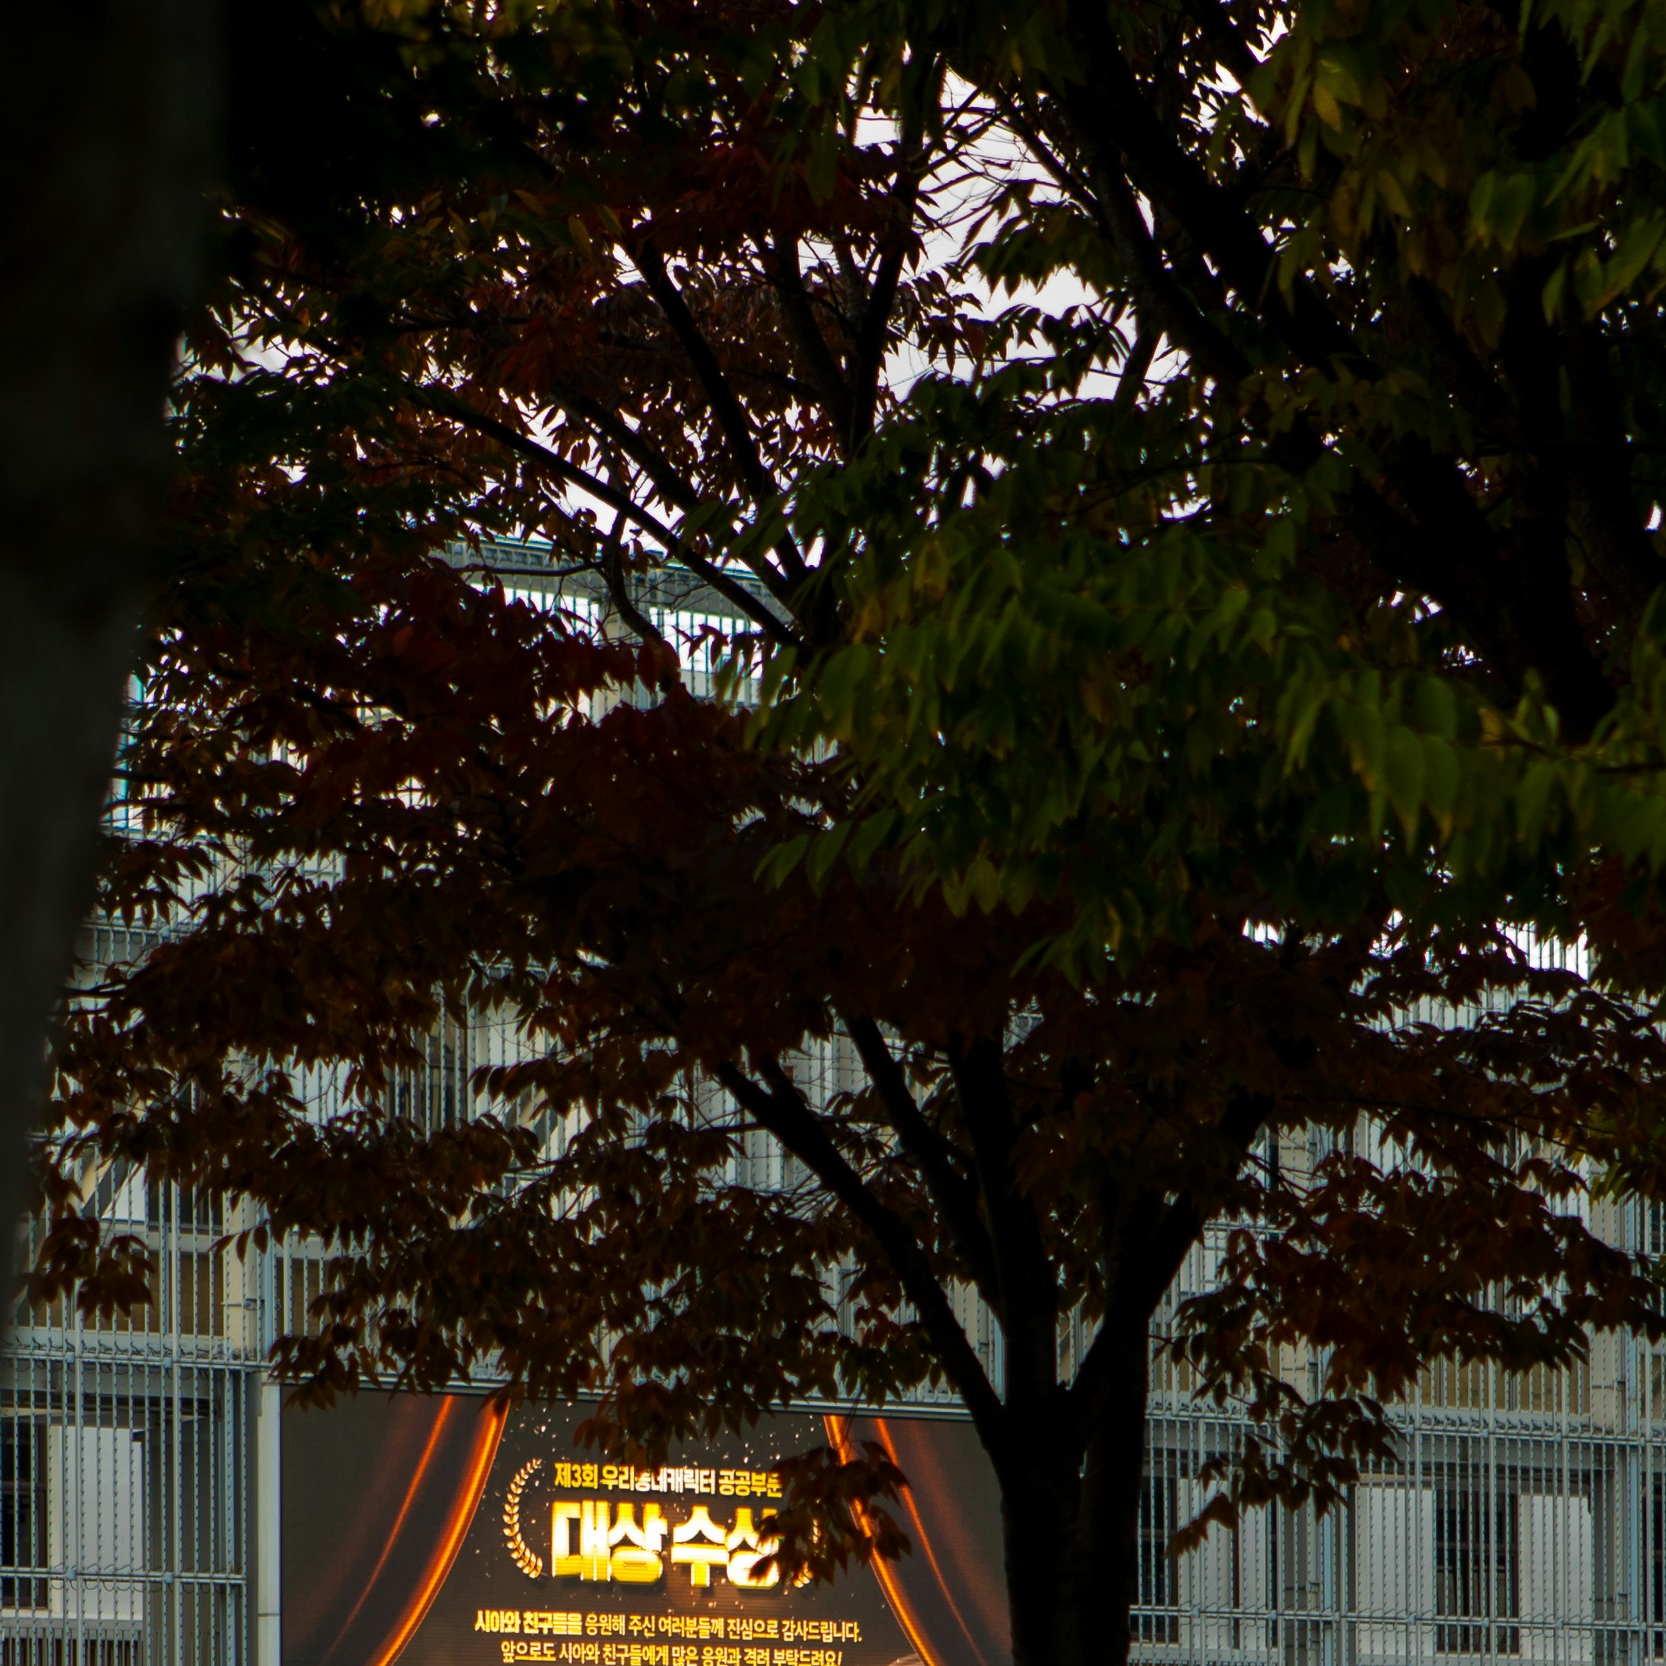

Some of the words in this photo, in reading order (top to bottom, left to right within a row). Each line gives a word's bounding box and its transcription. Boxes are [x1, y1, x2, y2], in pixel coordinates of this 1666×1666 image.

[554, 1462, 598, 1490] 제3회
[552, 1499, 668, 1585] 대상
[671, 1505, 781, 1590] 수상
[474, 1609, 520, 1633] 시아와
[523, 1611, 583, 1636] 친구들을
[585, 1613, 626, 1637] 응원해
[628, 1615, 656, 1638] 주신
[657, 1615, 725, 1639] 여러분들께
[727, 1617, 779, 1641] 진심으로
[781, 1619, 863, 1643] 감사드립니다.
[500, 1640, 556, 1664] 앞으로도
[559, 1642, 600, 1665] 시아와
[602, 1643, 669, 1666] 친구들에게
